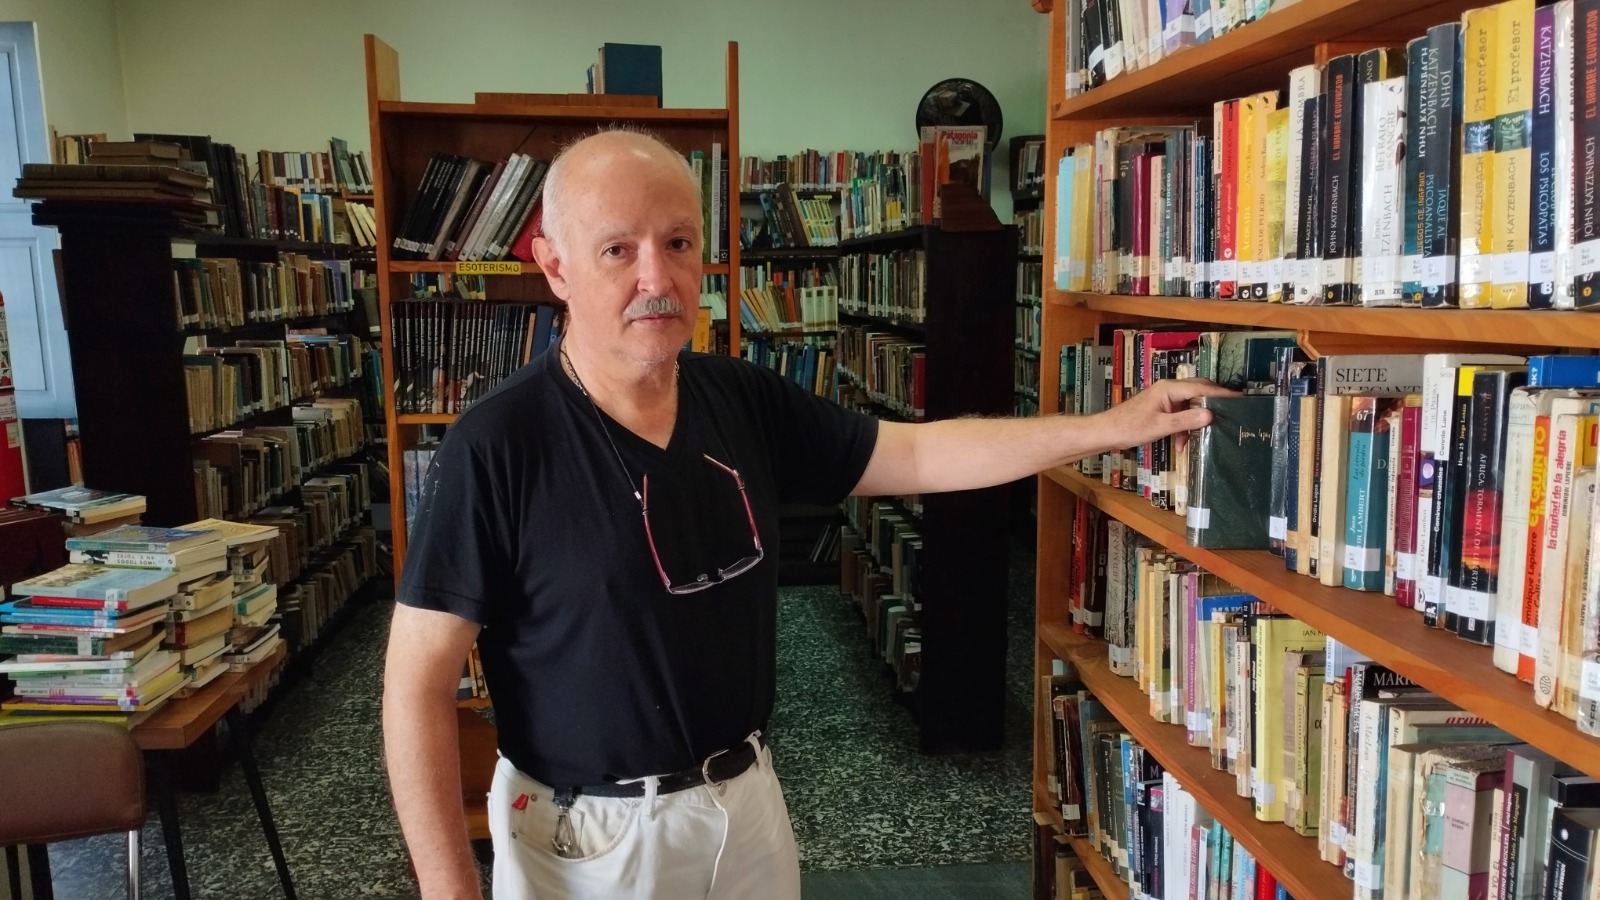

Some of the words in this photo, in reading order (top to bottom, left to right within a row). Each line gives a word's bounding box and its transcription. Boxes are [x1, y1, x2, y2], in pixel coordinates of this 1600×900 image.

[1509, 20, 1522, 82] profesor
[1586, 9, 1598, 64] EQUIVOCADO
[1476, 29, 1489, 93] profesor
[1539, 25, 1552, 114] KATZENBACH
[1296, 76, 1306, 124] SOMBRA
[1334, 74, 1343, 118] EQUIVOCADO
[1427, 48, 1439, 135] KATZENBACH
[1440, 70, 1452, 107] JOHN
[1585, 67, 1597, 104] HOMBRE
[1585, 107, 1596, 118] EL
[942, 131, 978, 140] Patagonia
[1333, 120, 1341, 149] HOMBRE
[1386, 109, 1395, 158] SANGRE
[1332, 151, 1341, 160] EL
[1540, 152, 1551, 173] LOS
[1584, 136, 1596, 205] KATZENBACH
[1292, 155, 1301, 216] KATZENBACH
[1330, 175, 1339, 228] KATZENBACH
[1473, 156, 1484, 234] KATZENBACH
[1507, 157, 1516, 234] KATZENBACH
[1424, 174, 1435, 257] PSICOANALISTA
[1437, 189, 1446, 220] JAQUE
[1538, 177, 1552, 245] PSICÓPATAS
[1437, 224, 1446, 238] AL
[1584, 208, 1595, 238] JOHN
[459, 263, 520, 272] ESOTERISMO
[1336, 368, 1388, 382] SIETE
[1356, 409, 1369, 422] 67
[1530, 426, 1547, 503] QUINTO
[1552, 430, 1568, 469] alegría
[1436, 466, 1444, 500] cruzados
[1478, 453, 1488, 486] ÁFRICA:
[1551, 472, 1562, 483] la
[1357, 487, 1366, 532] LAMBERT
[1549, 486, 1561, 499] de
[1561, 484, 1570, 517] DOMINIQUE
[1433, 502, 1441, 532] Caminos
[1474, 488, 1485, 536] TORMENTA
[1528, 505, 1538, 527] EL
[1547, 501, 1560, 534] ciudad
[1473, 538, 1481, 549] DE
[1527, 531, 1538, 575] Lapierre
[1546, 535, 1558, 549] la
[1582, 548, 1591, 580] MUJERES
[1523, 576, 1536, 627] ominique
[1582, 582, 1589, 593] DE
[1354, 673, 1363, 700] MARIO
[1363, 724, 1373, 761] MacLean
[1502, 869, 1507, 878] EN
